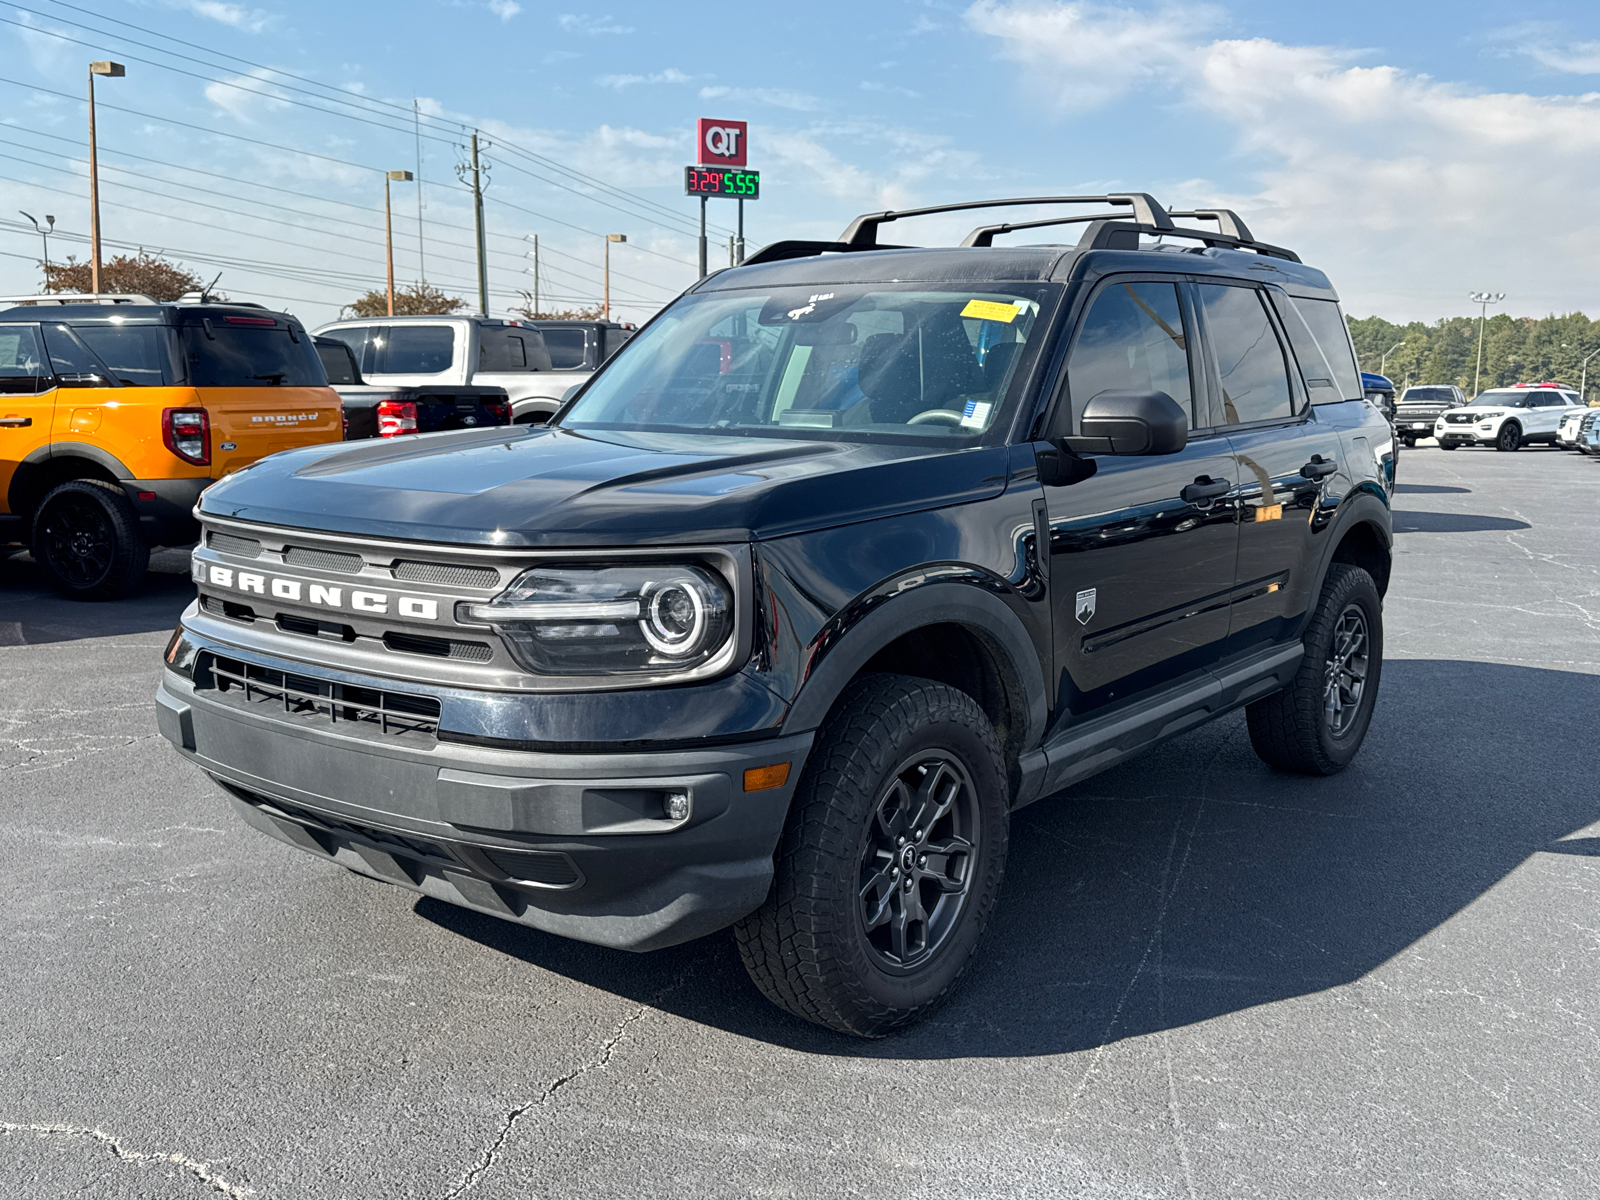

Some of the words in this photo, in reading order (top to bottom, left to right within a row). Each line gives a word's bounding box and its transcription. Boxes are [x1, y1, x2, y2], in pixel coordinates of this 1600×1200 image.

[705, 126, 741, 158] QT
[252, 413, 318, 423] BRONCO
[220, 441, 236, 451] Ford
[210, 565, 438, 621] BRONCO
